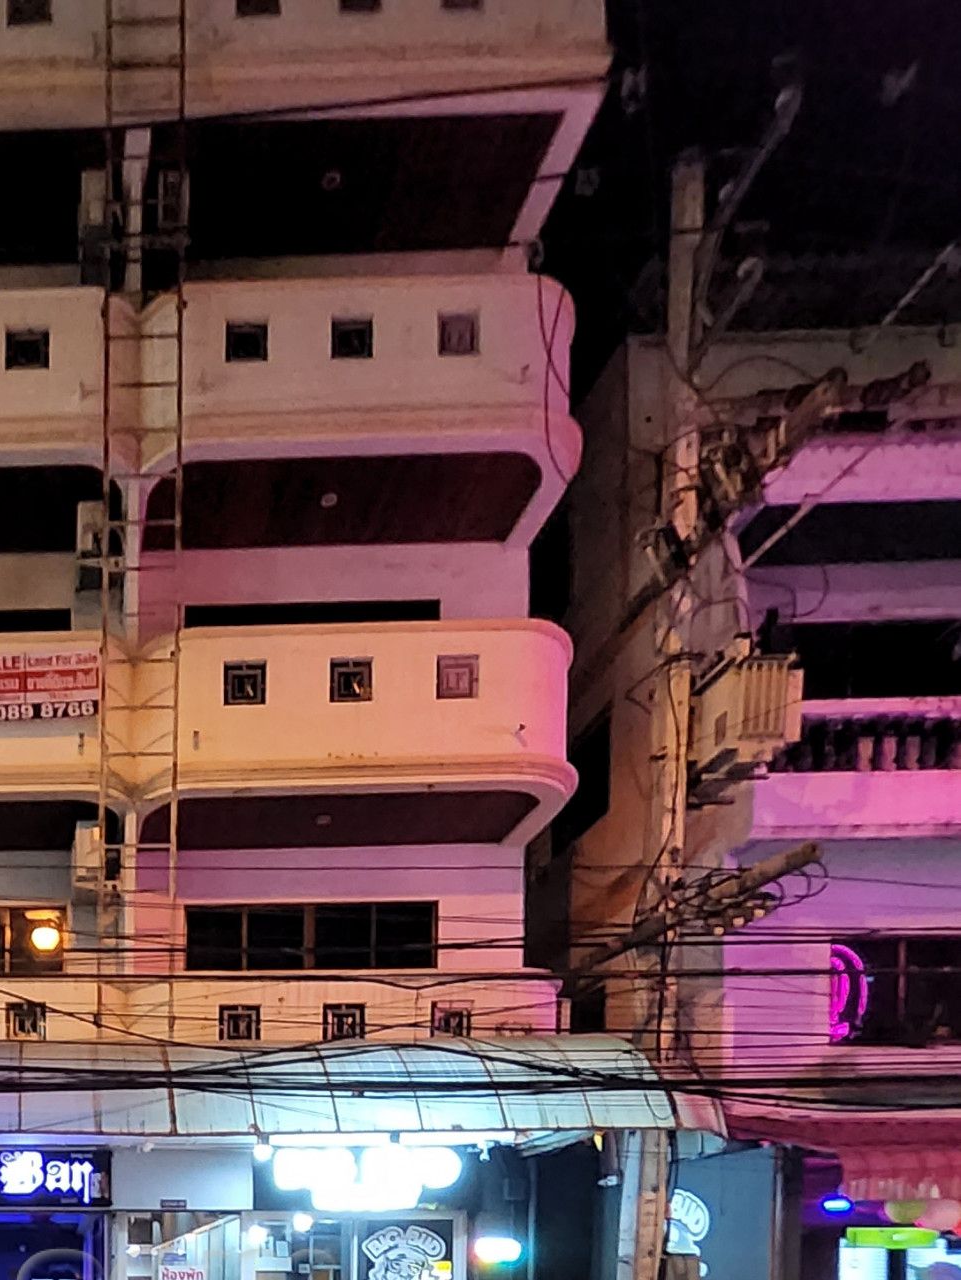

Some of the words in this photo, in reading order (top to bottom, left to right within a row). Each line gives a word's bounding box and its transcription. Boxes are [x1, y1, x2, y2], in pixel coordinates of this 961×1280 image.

[28, 655, 53, 668] Land
[55, 654, 73, 666] For
[76, 652, 98, 665] Sale
[40, 701, 95, 718] 8766
[0, 1151, 94, 1205] Bar
